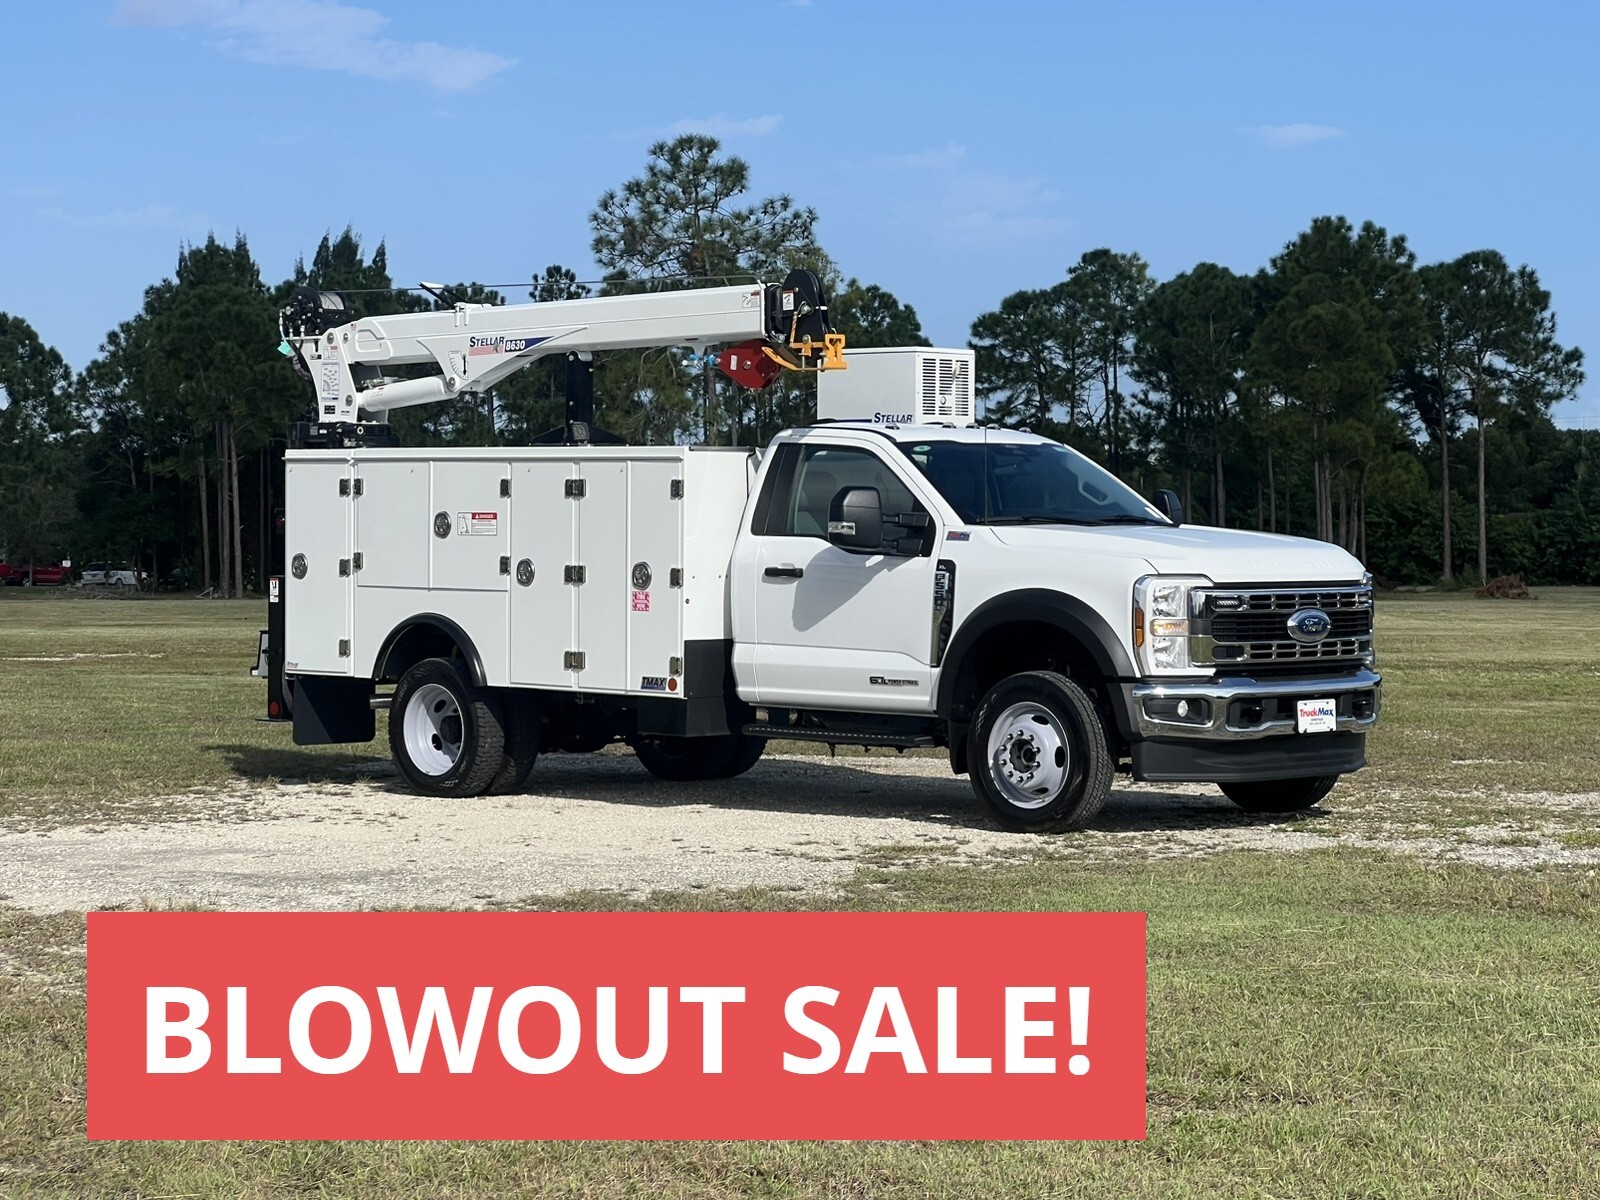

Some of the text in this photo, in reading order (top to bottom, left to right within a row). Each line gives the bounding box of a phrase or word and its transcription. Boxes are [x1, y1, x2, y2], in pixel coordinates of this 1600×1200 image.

[469, 336, 526, 351] STELLAR 8630
[874, 412, 913, 423] STELLAR
[1303, 618, 1324, 632] Ford
[641, 676, 664, 687] TMAX
